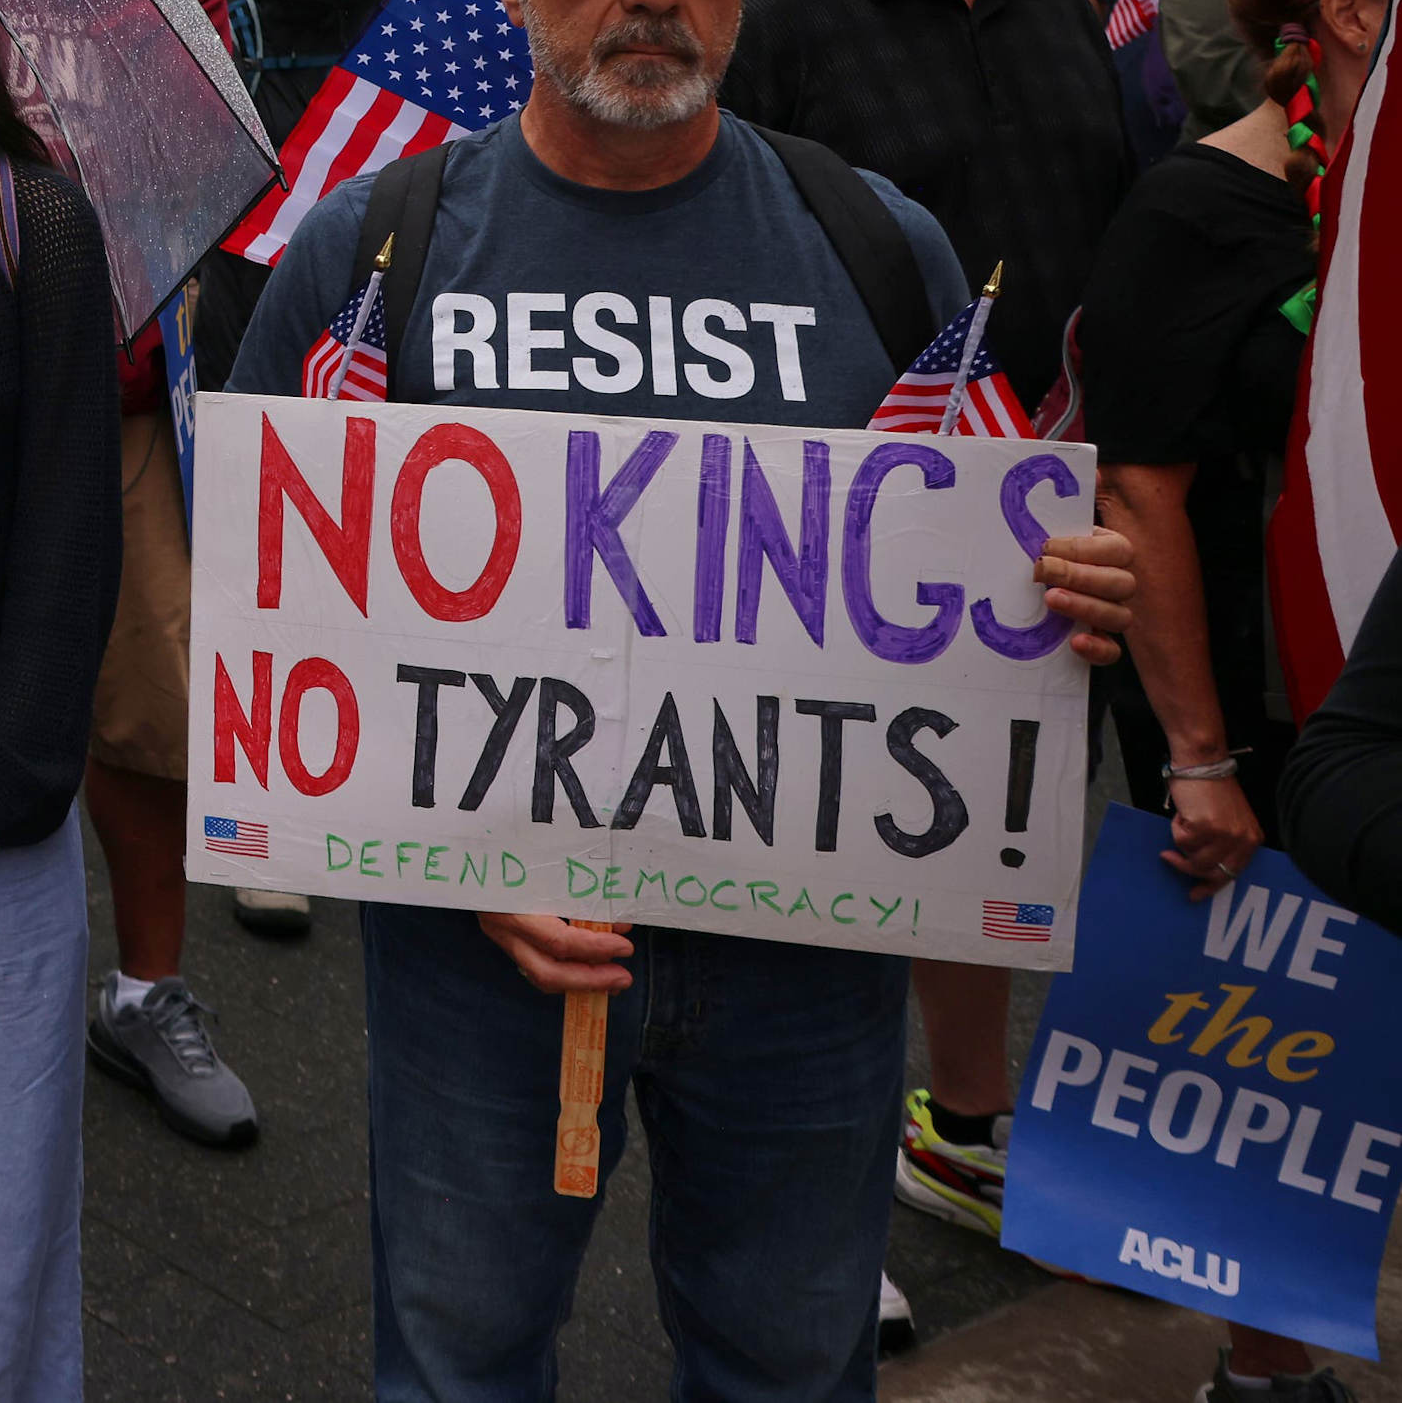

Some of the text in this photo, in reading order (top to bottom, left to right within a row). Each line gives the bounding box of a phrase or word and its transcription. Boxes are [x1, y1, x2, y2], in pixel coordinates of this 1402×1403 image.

[431, 289, 817, 402] RESIST
[255, 409, 1081, 666] NO KINGS
[211, 649, 1040, 870] NO TYRANTS!
[324, 832, 924, 938] DEFEND DEMOCRACY!
[1202, 879, 1360, 991] WE
[1147, 982, 1336, 1084] the
[1030, 1028, 1402, 1214] PEOPLE
[1117, 1226, 1241, 1298] ACLU
